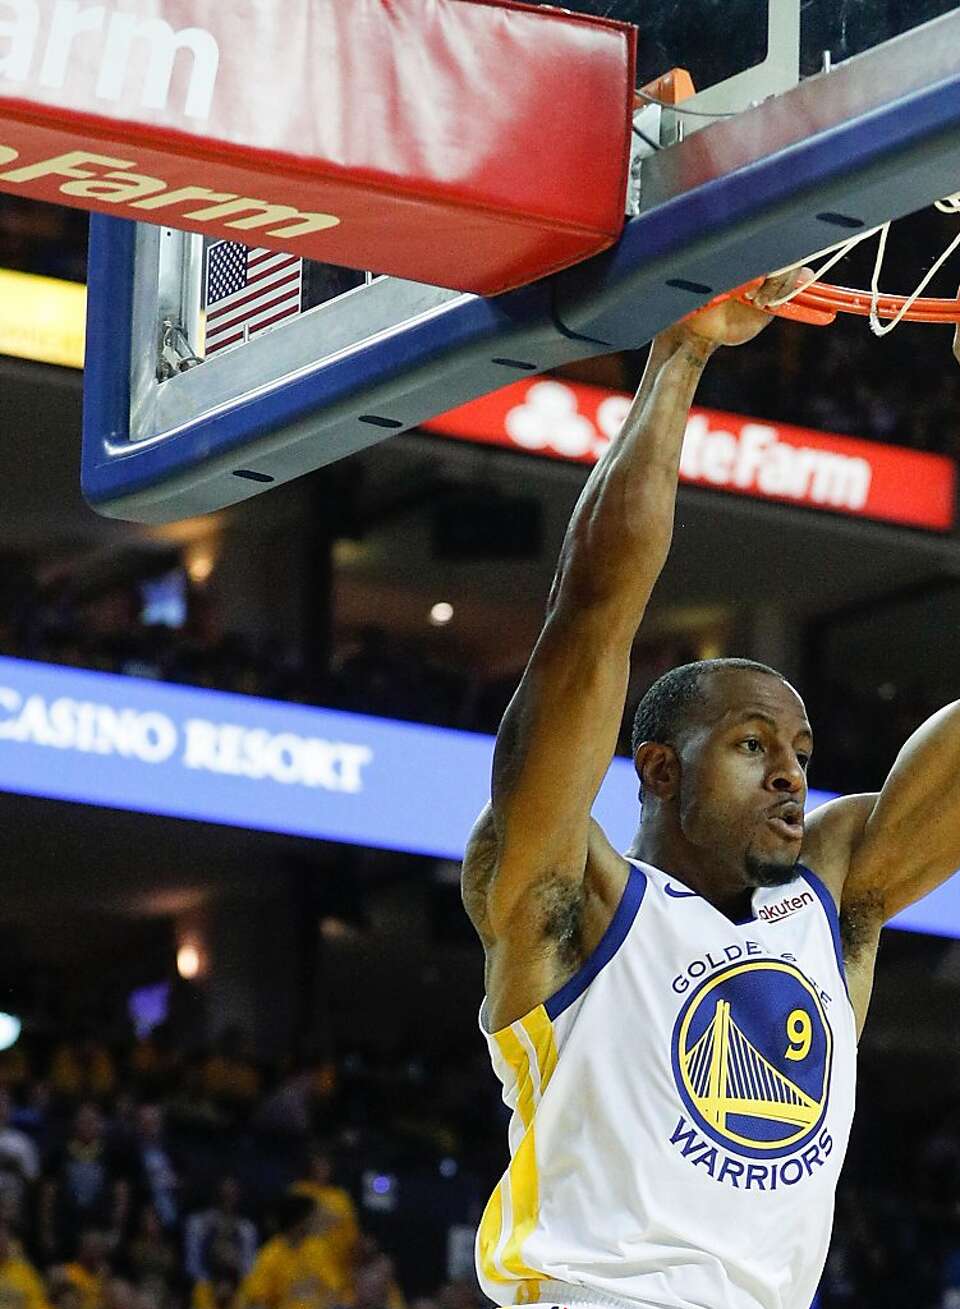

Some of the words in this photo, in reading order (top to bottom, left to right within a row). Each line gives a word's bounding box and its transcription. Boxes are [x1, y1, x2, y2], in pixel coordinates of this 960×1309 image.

[0, 150, 341, 238] Farm
[184, 718, 374, 793] RESORT
[757, 892, 814, 921] akuten
[671, 941, 769, 994] GOLDE
[784, 1009, 812, 1061] 9
[668, 1115, 833, 1191] WARRIORS
